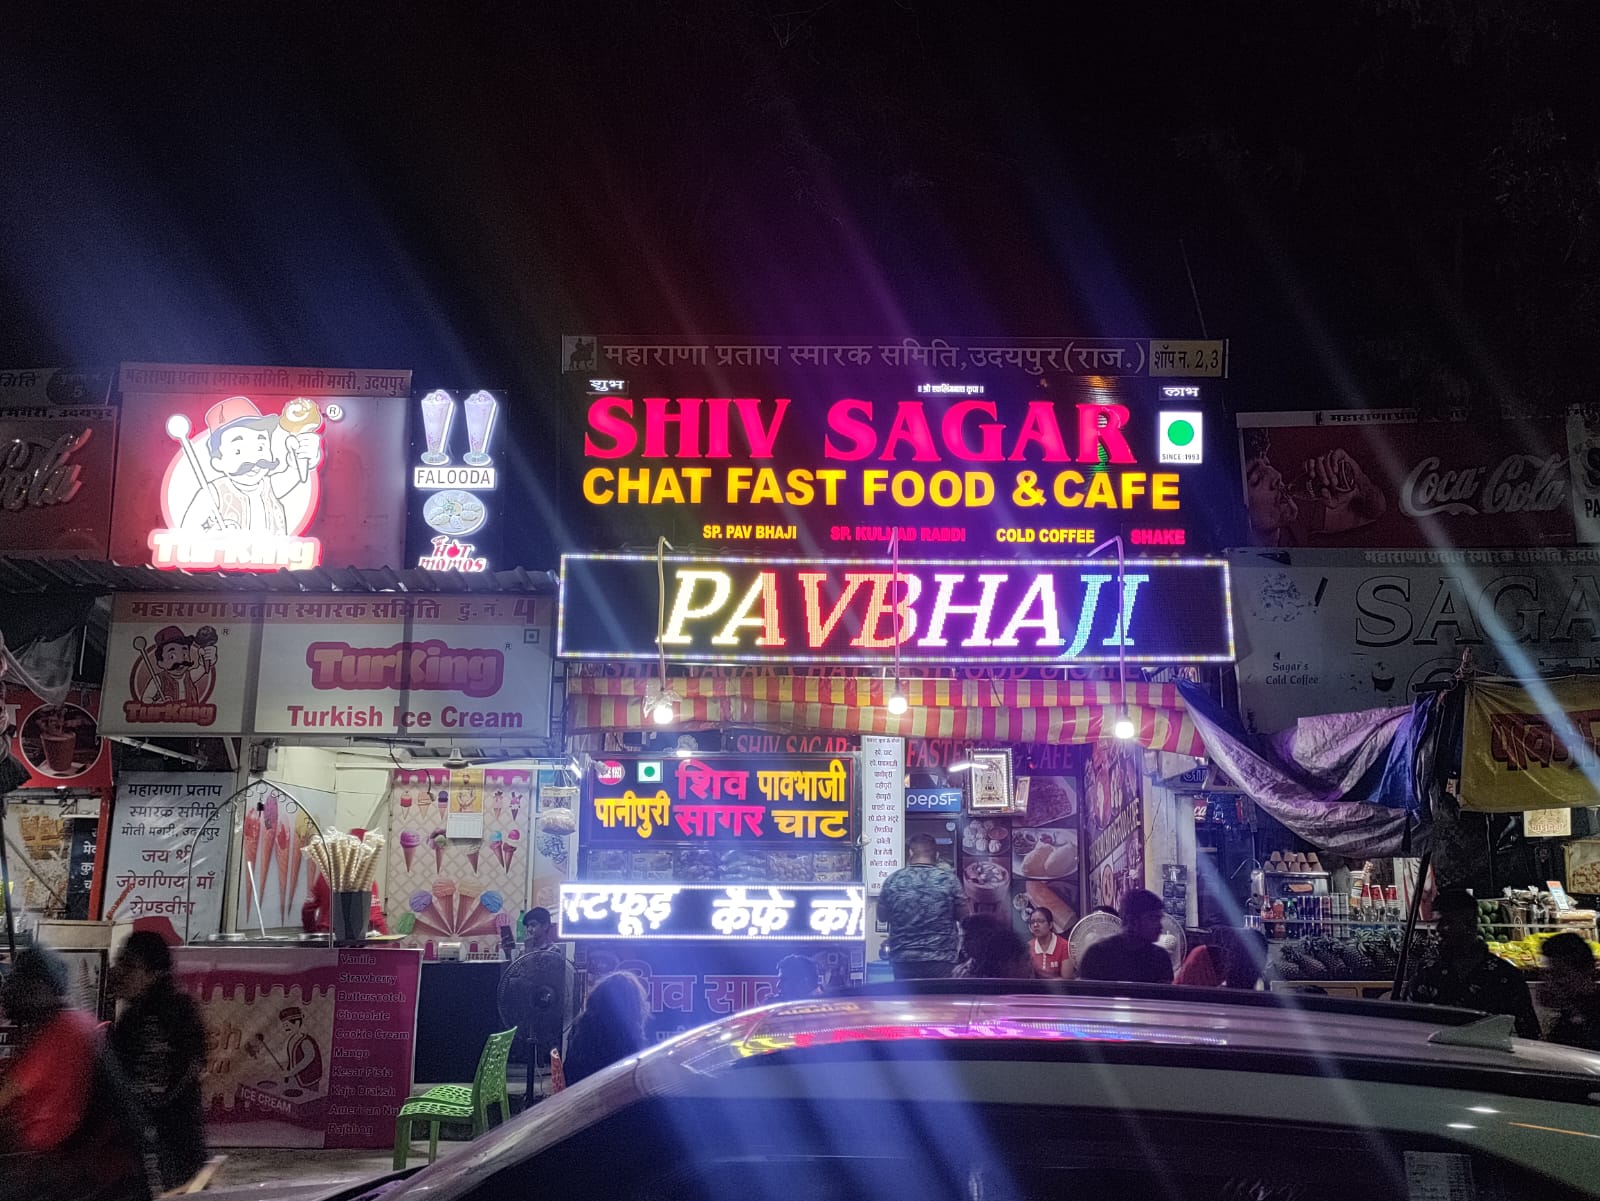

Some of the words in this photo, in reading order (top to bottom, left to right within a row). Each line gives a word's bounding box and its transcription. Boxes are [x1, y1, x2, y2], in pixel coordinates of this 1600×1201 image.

[601, 344, 709, 367] महाराणा
[714, 344, 782, 367] प्रताप
[787, 344, 874, 367] स्मारक
[364, 374, 405, 396] उदयपुर
[589, 379, 624, 392] शुभ
[1162, 387, 1200, 397] लाभ
[583, 396, 791, 460] SHIV
[824, 398, 1138, 465] SAGAR
[417, 469, 491, 485] FALOODA
[582, 467, 712, 506] CHAT
[726, 467, 847, 507] FAST
[863, 469, 996, 508] FOOD
[1012, 470, 1047, 507] &
[1053, 471, 1181, 510] CAFE
[702, 524, 723, 540] SP.
[725, 524, 753, 540] PAV
[755, 524, 798, 540] BHAJI
[830, 526, 852, 541] SP.
[996, 528, 1036, 543] COLD
[1038, 528, 1095, 544] COFFEE
[1130, 529, 1186, 545] SHAKE
[132, 600, 229, 619] महाराणा
[231, 601, 290, 620] प्रताप
[295, 600, 367, 620] स्मारक
[371, 597, 441, 620] समिति
[513, 599, 537, 625] 4
[656, 570, 1151, 660] PAVBHAJI
[288, 705, 383, 728] Turkish
[394, 705, 431, 728] Ice
[440, 705, 523, 729] Cream
[675, 760, 749, 801] शिव
[757, 759, 847, 802] पावभाजी
[128, 784, 183, 798] महाराणा
[186, 784, 223, 797] प्रताप
[129, 806, 175, 818] स्मारक
[594, 790, 671, 839] पानीपुरी
[121, 822, 145, 836] मोती
[673, 805, 766, 837] सागर
[771, 809, 849, 839] चाट
[141, 849, 171, 863] जय
[116, 869, 193, 889] जोगणिय
[196, 870, 216, 889] माँ
[561, 884, 682, 936] स्टफूड
[340, 953, 377, 965] Vanilla
[339, 972, 398, 986] Strawberry
[338, 990, 407, 1003] Butterscotch
[337, 1009, 391, 1021] Chocolate
[335, 1027, 373, 1040] Cookie
[375, 1028, 410, 1040] Cream
[333, 1046, 370, 1061] Mango
[332, 1065, 364, 1077] Kesar
[365, 1066, 394, 1078] Pista
[240, 1086, 258, 1103] ICE
[258, 1090, 292, 1114] CREAM
